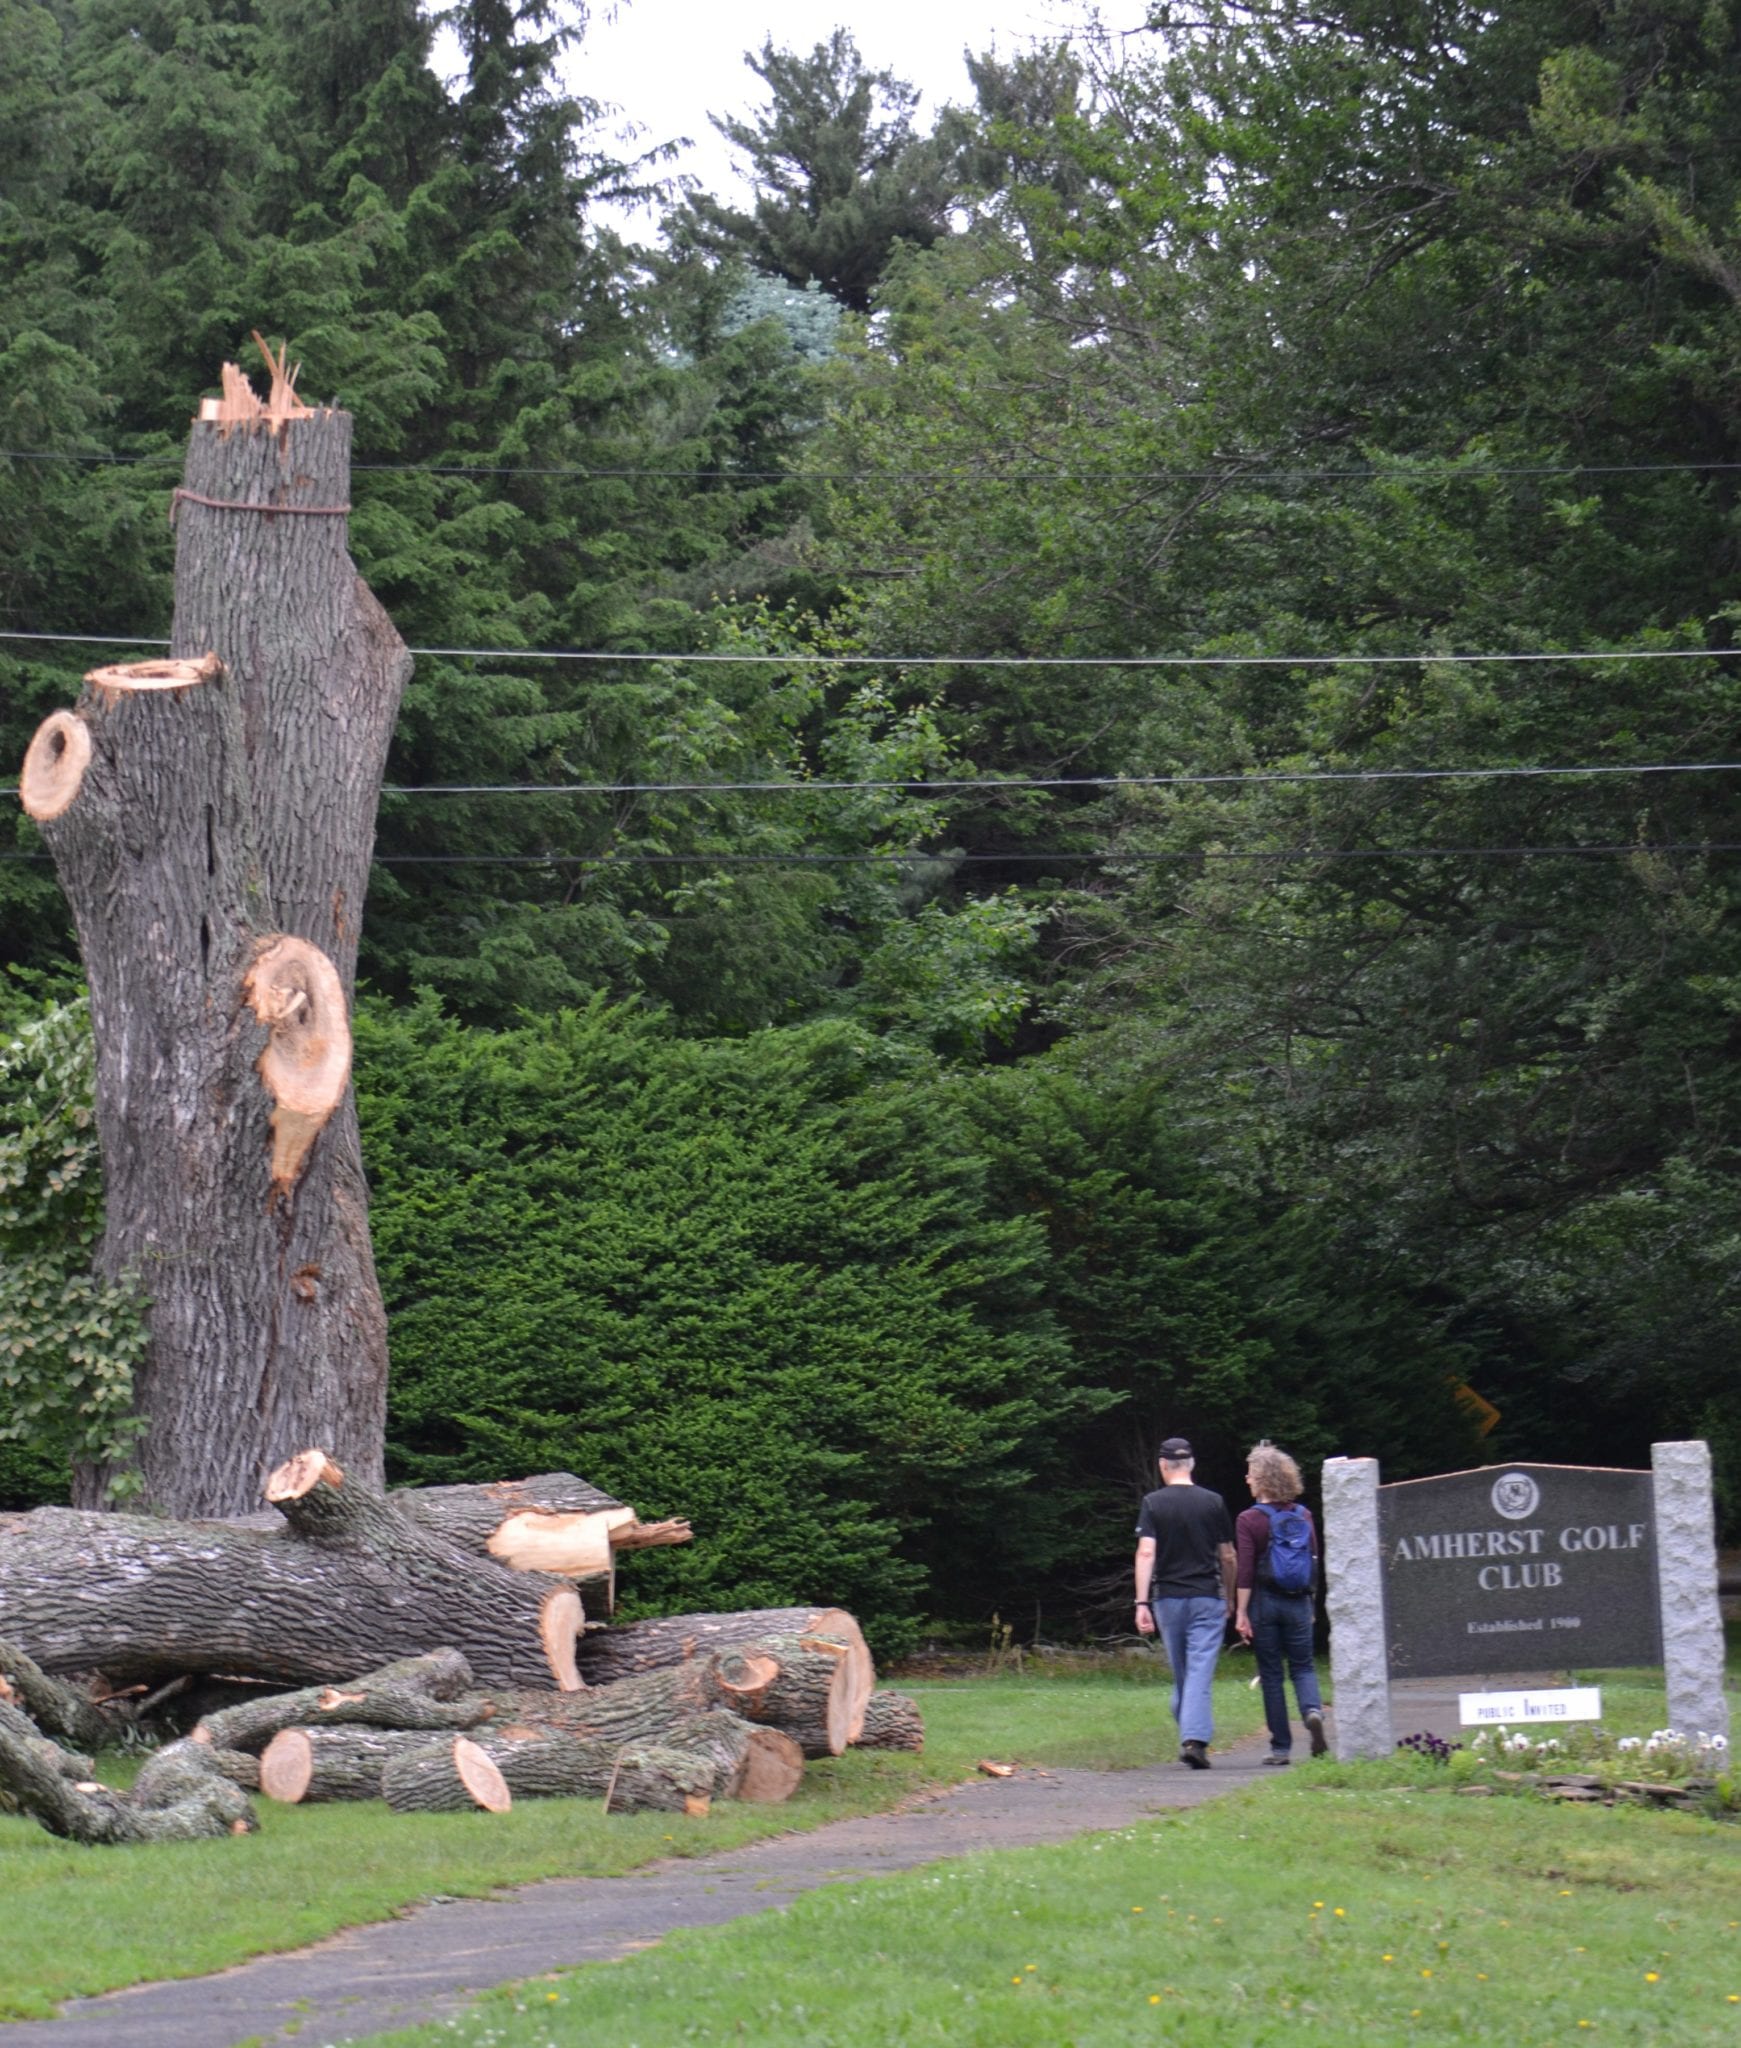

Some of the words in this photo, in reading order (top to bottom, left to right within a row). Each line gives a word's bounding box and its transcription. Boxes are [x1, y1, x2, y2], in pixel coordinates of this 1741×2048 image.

[1394, 1529, 1544, 1561] AMHERST
[1559, 1524, 1646, 1552] GOLF
[1477, 1563, 1562, 1590] CLUB
[1467, 1619, 1543, 1634] Established
[1477, 1706, 1515, 1718] PUBLIC
